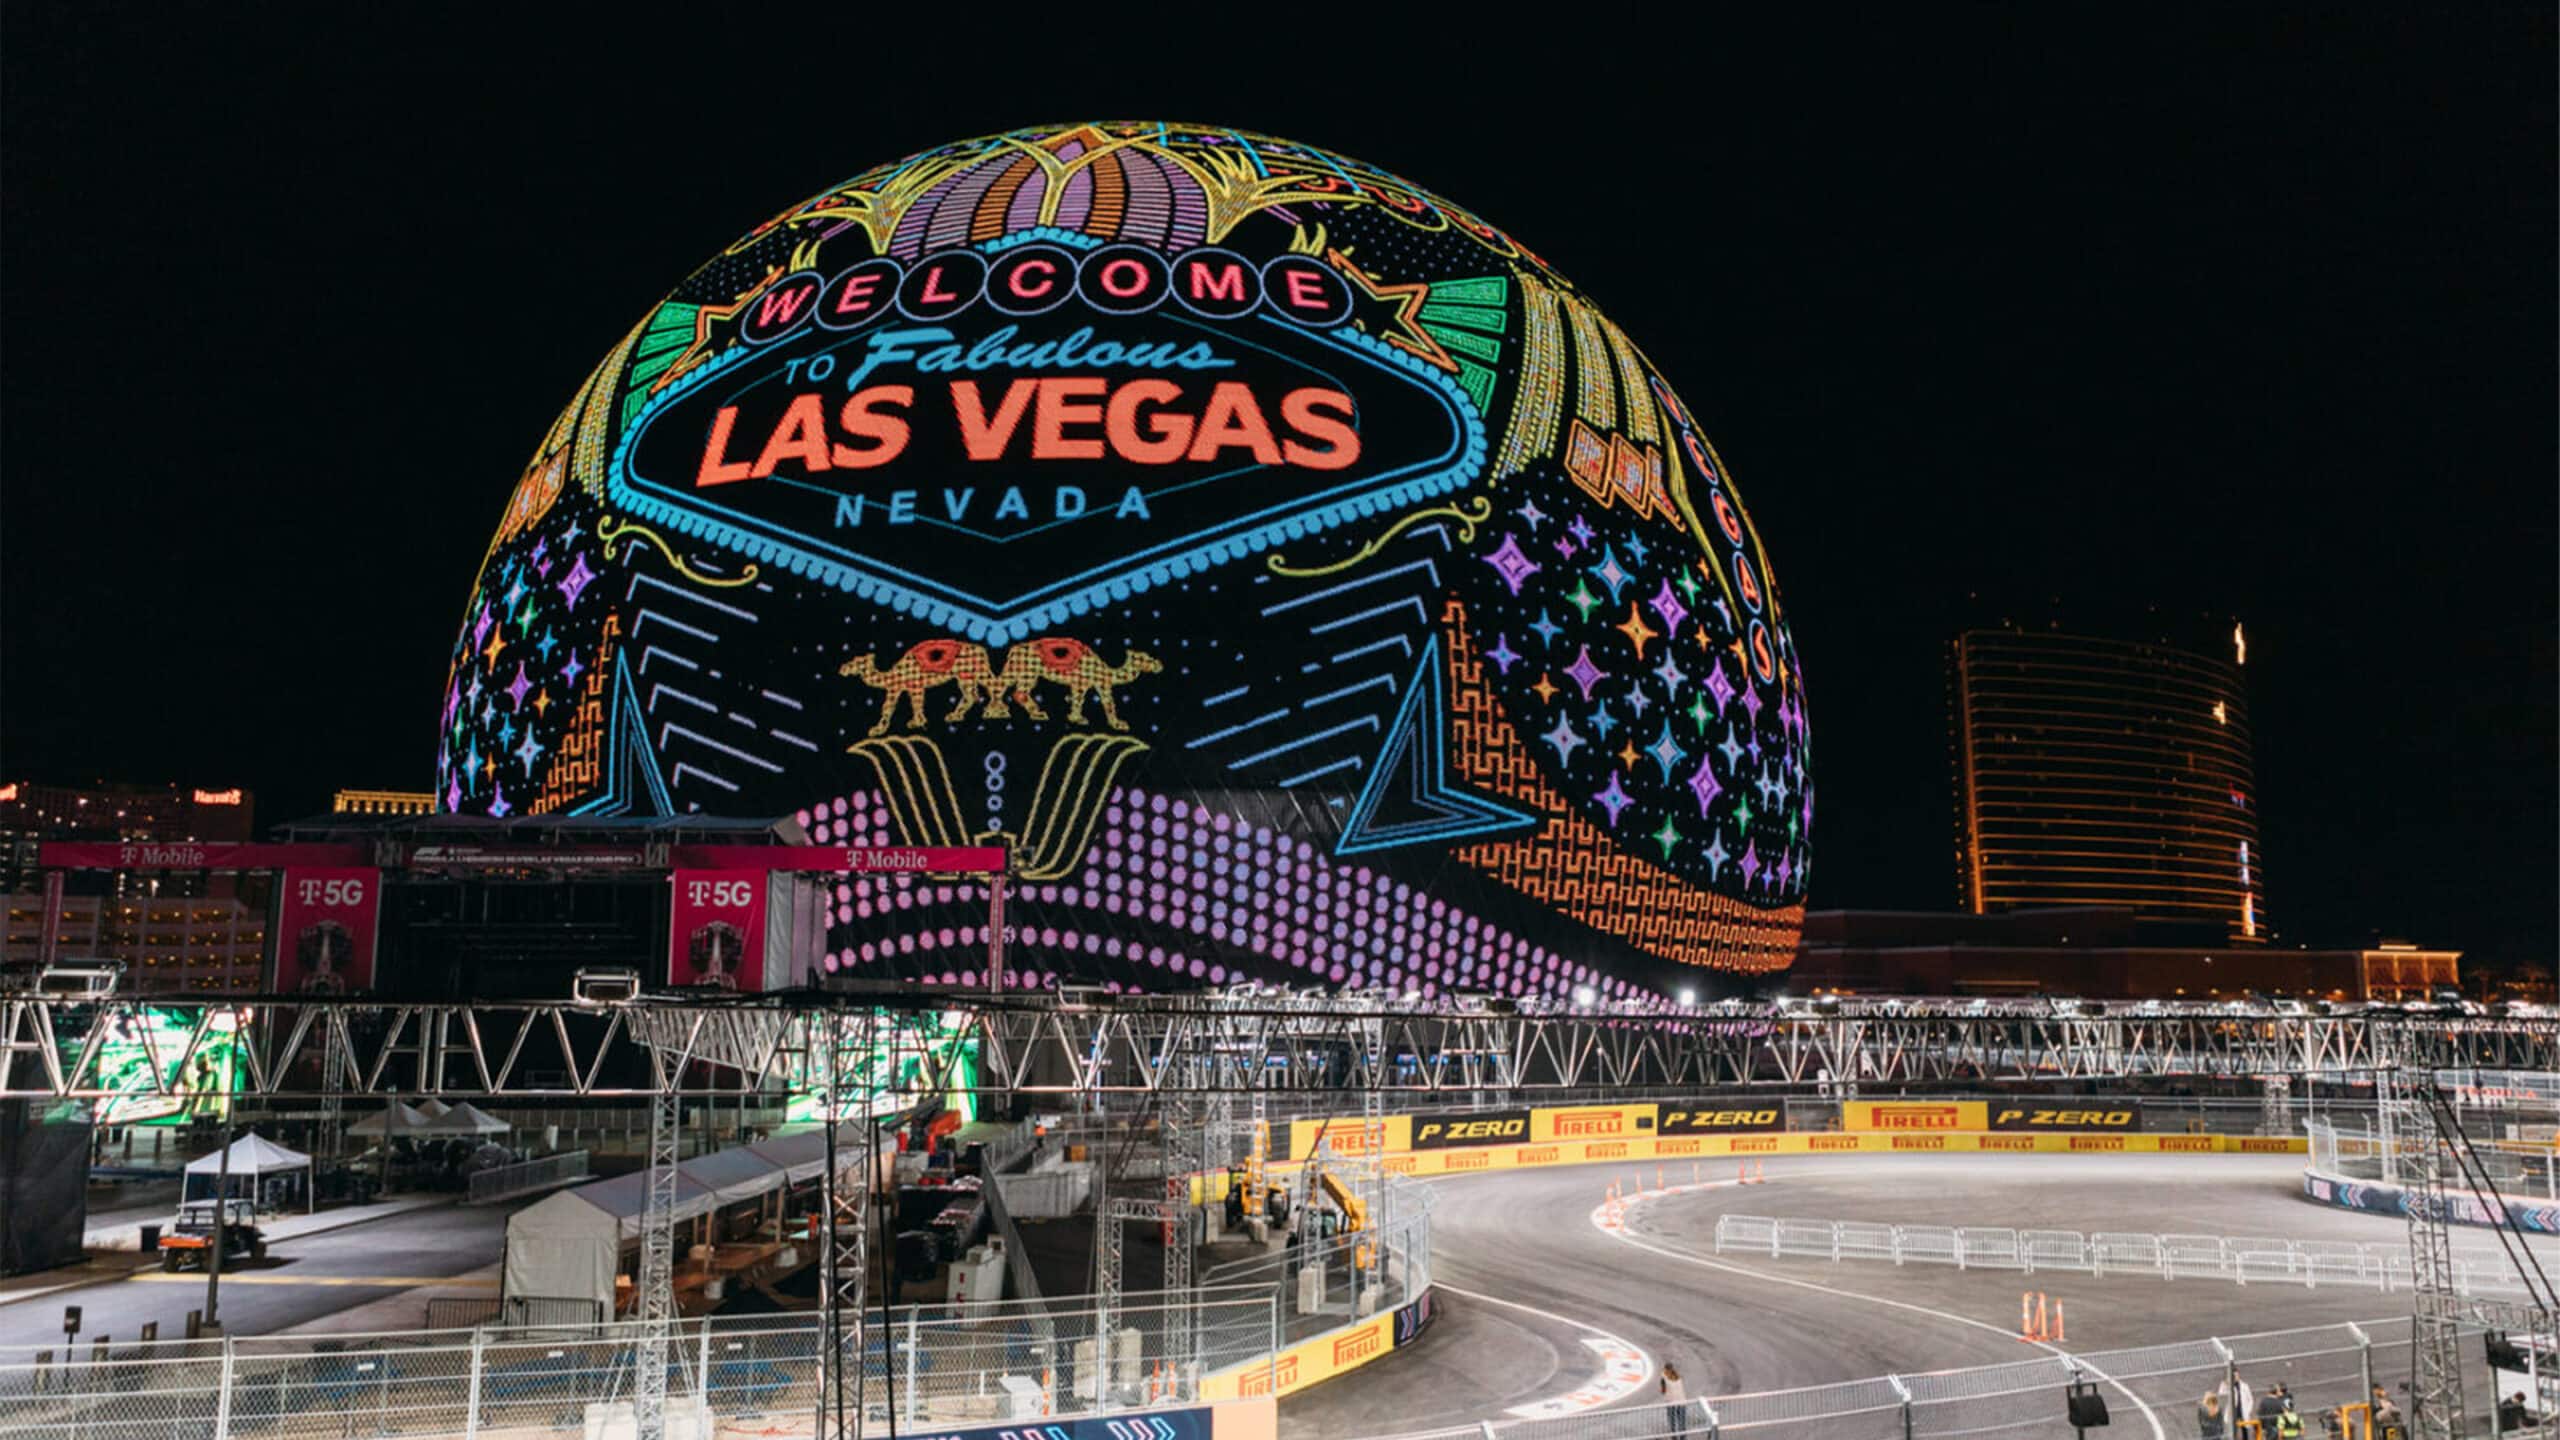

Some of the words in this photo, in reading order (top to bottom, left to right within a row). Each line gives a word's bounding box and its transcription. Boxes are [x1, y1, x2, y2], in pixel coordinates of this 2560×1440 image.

[757, 260, 1329, 328] WELCOME
[786, 354, 835, 385] TO
[847, 324, 1235, 392] Fabulous
[696, 384, 915, 487] LAS
[950, 377, 1361, 470] VEGAS
[835, 486, 1150, 528] NEVADA
[142, 847, 205, 865] Mobile
[867, 851, 928, 869] Mobile
[323, 880, 364, 905] 5G
[713, 881, 752, 907] 5G
[1554, 1111, 1623, 1136] PIRELLI
[1664, 1112, 1689, 1127] P
[1691, 1110, 1777, 1125] ZERO
[1872, 1107, 1958, 1128] PIRELLI
[1997, 1110, 2023, 1124] P
[2029, 1110, 2132, 1125] ZERO
[1418, 1123, 1441, 1141] P
[1445, 1118, 1525, 1139] ZERO
[1585, 1142, 1628, 1159] PIRELLI
[1655, 1139, 1700, 1154] PIRELLI
[1730, 1137, 1777, 1151] PIRELLI
[1809, 1136, 1859, 1149] PIRELLI
[1892, 1136, 1944, 1149] PIRELLI
[1979, 1135, 2034, 1149] PIRELLI
[2070, 1136, 2124, 1150] PIRELLI
[2159, 1136, 2212, 1149] PIRELLI
[1517, 1147, 1559, 1164] PIRELLI
[1333, 1324, 1380, 1367] PIRELLI
[1239, 1355, 1298, 1398] PIRELLI
